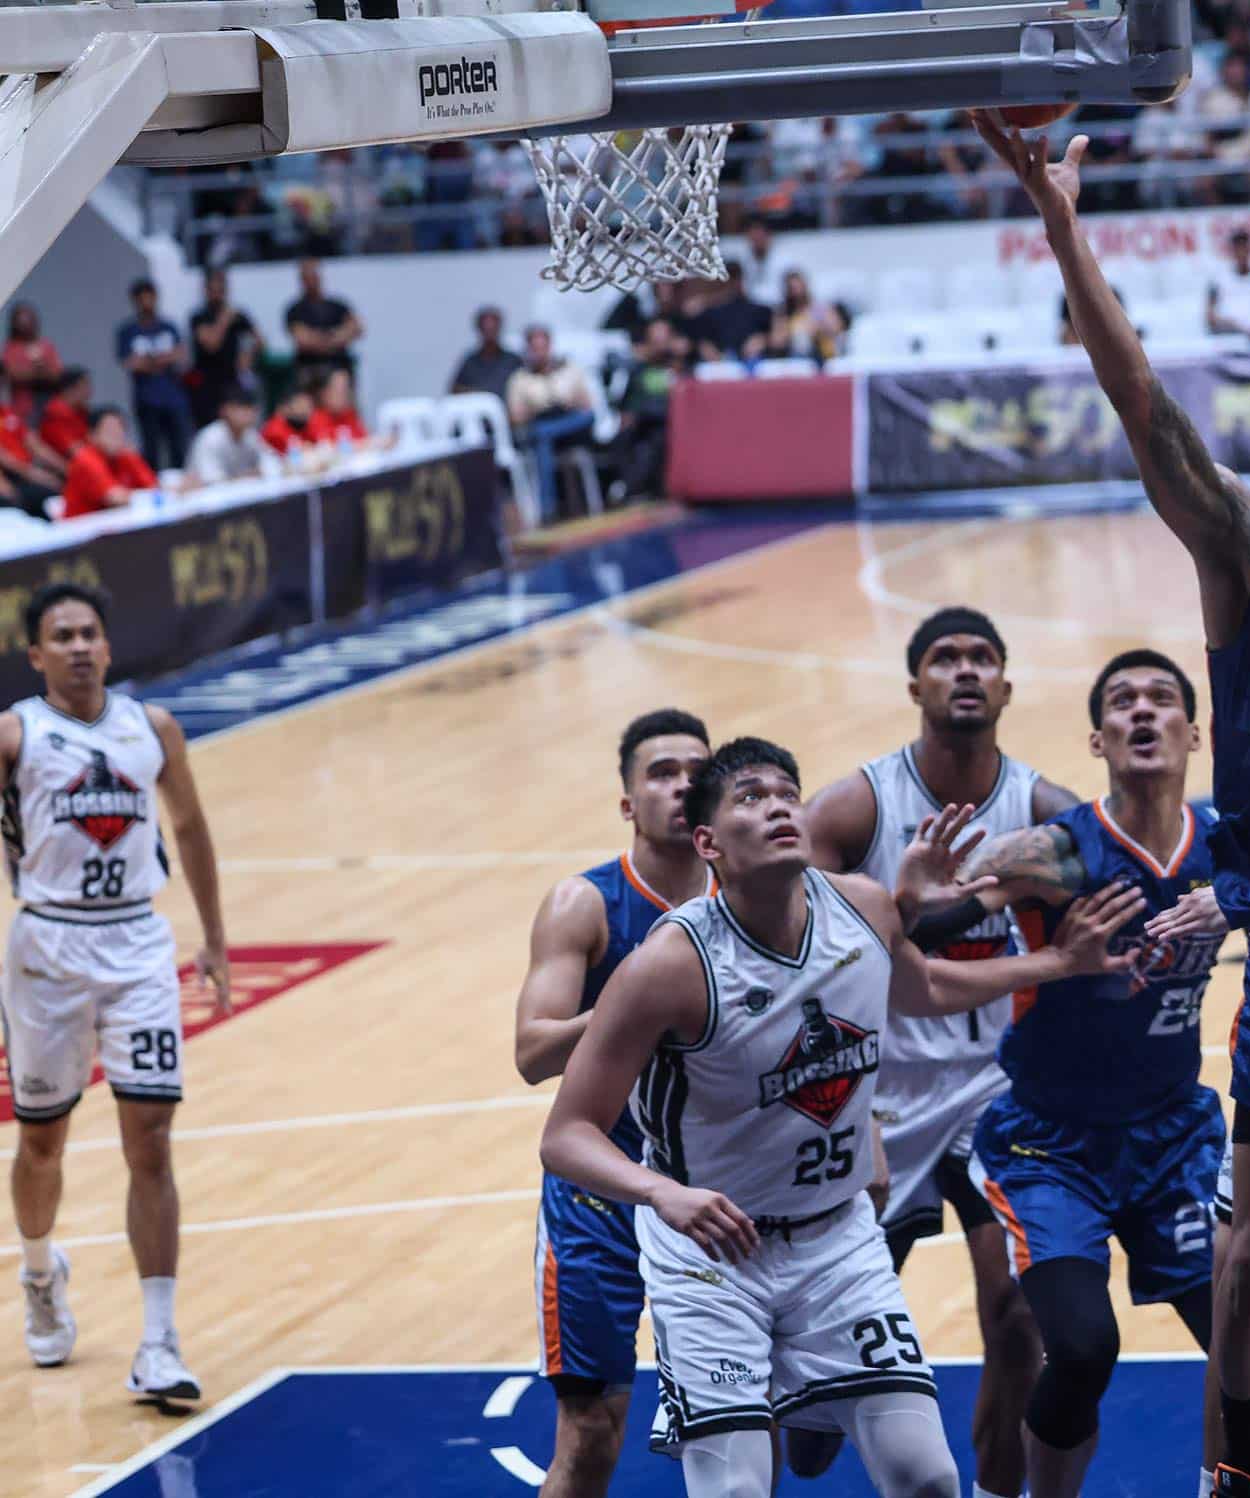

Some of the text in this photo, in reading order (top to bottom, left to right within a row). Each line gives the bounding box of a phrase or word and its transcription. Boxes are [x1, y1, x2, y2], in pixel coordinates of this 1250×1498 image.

[82, 858, 127, 899] 28
[130, 1029, 177, 1071] 28
[760, 1030, 879, 1108] BOSSING
[792, 1125, 855, 1186] 25
[853, 1313, 923, 1370] 25
